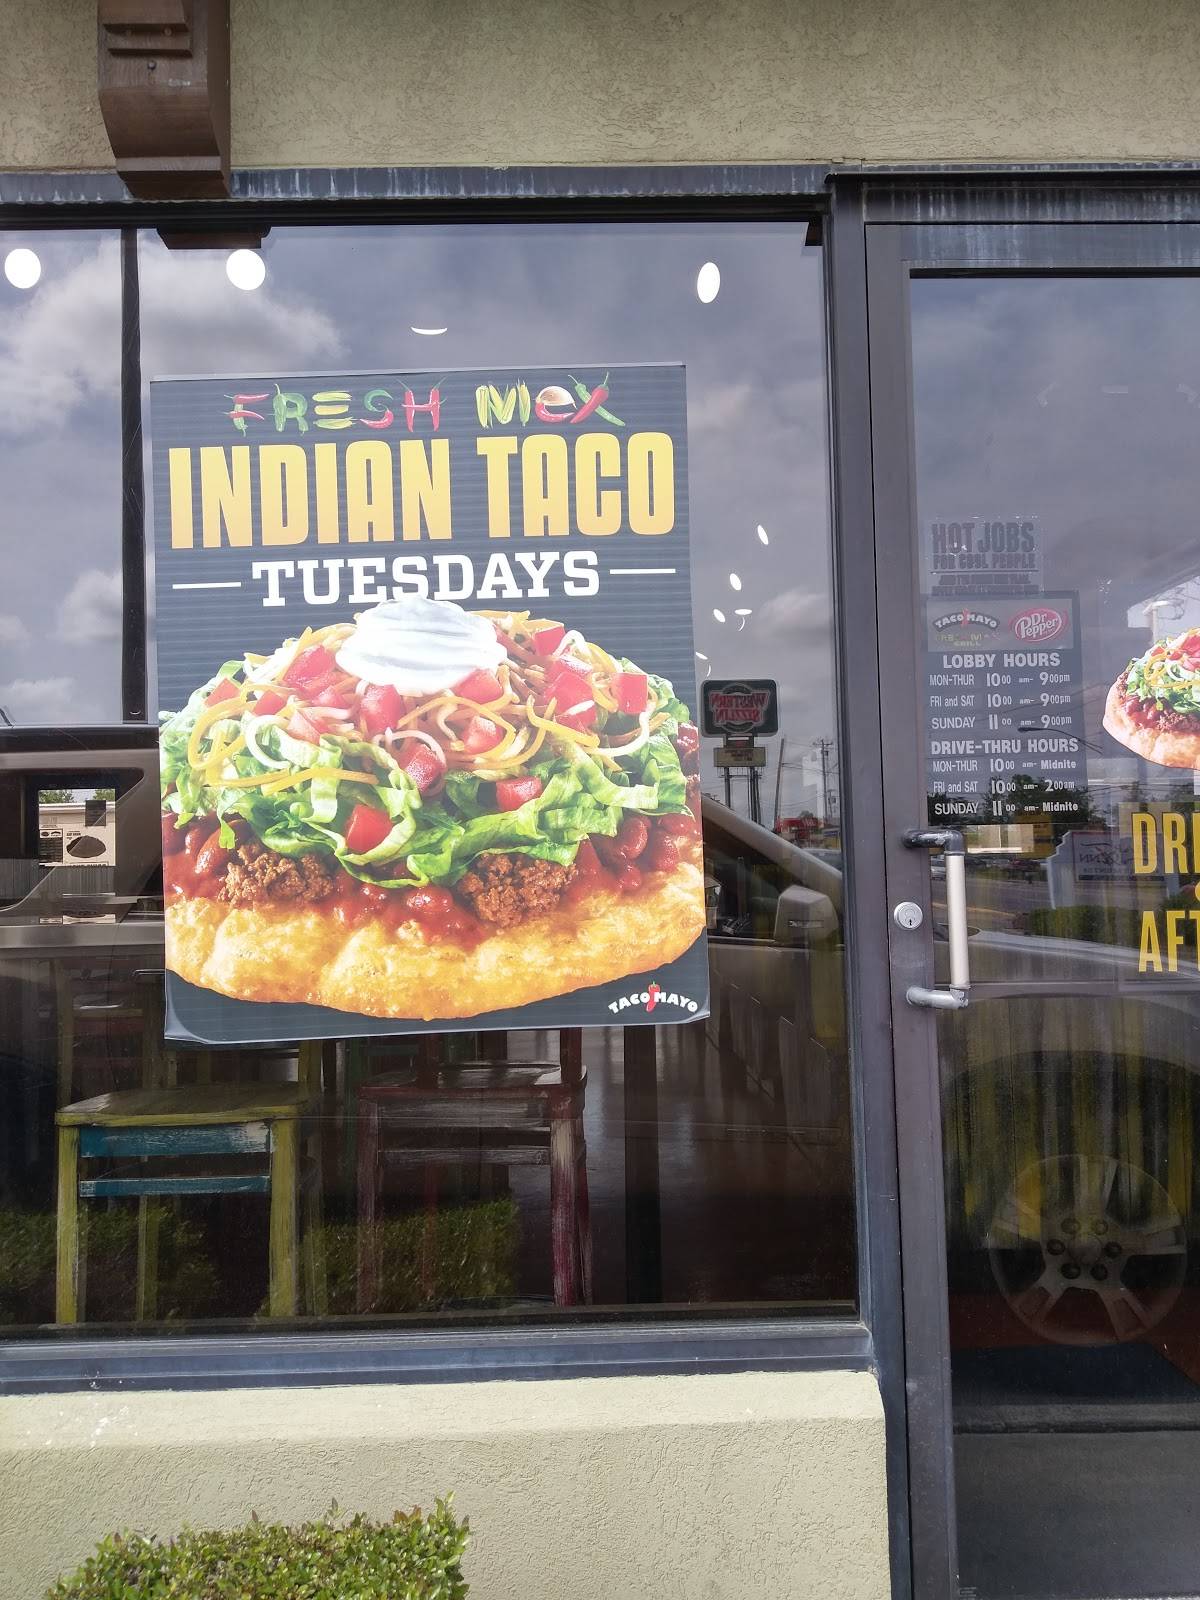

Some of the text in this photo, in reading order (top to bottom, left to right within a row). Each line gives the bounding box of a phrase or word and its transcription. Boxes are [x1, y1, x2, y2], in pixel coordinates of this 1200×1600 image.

[224, 376, 449, 437] FRESH
[168, 431, 676, 549] INDIAN TACO
[931, 521, 1035, 553] HOT JOBS
[251, 550, 600, 607] TUESDAYS
[934, 613, 998, 629] TACO MAYO
[1031, 612, 1048, 624] Dr
[1020, 615, 1059, 640] Pepper
[943, 652, 1061, 669] LOBBY HOURS
[929, 673, 975, 686] MON-THUR
[930, 696, 942, 707] FRI
[944, 695, 958, 707] and
[961, 695, 975, 706] SAT
[931, 716, 976, 730] SUNDAY
[931, 738, 1079, 755] DRIVE-THRU HOURS
[932, 760, 978, 772] MON-THUR
[1040, 759, 1077, 769] Midnite
[933, 781, 945, 793] FRI
[948, 781, 962, 793] and
[964, 781, 979, 793] SAT
[934, 802, 979, 815] SUNDAY
[1042, 801, 1079, 811] Midnite
[608, 992, 698, 1014] TACO MAYO
